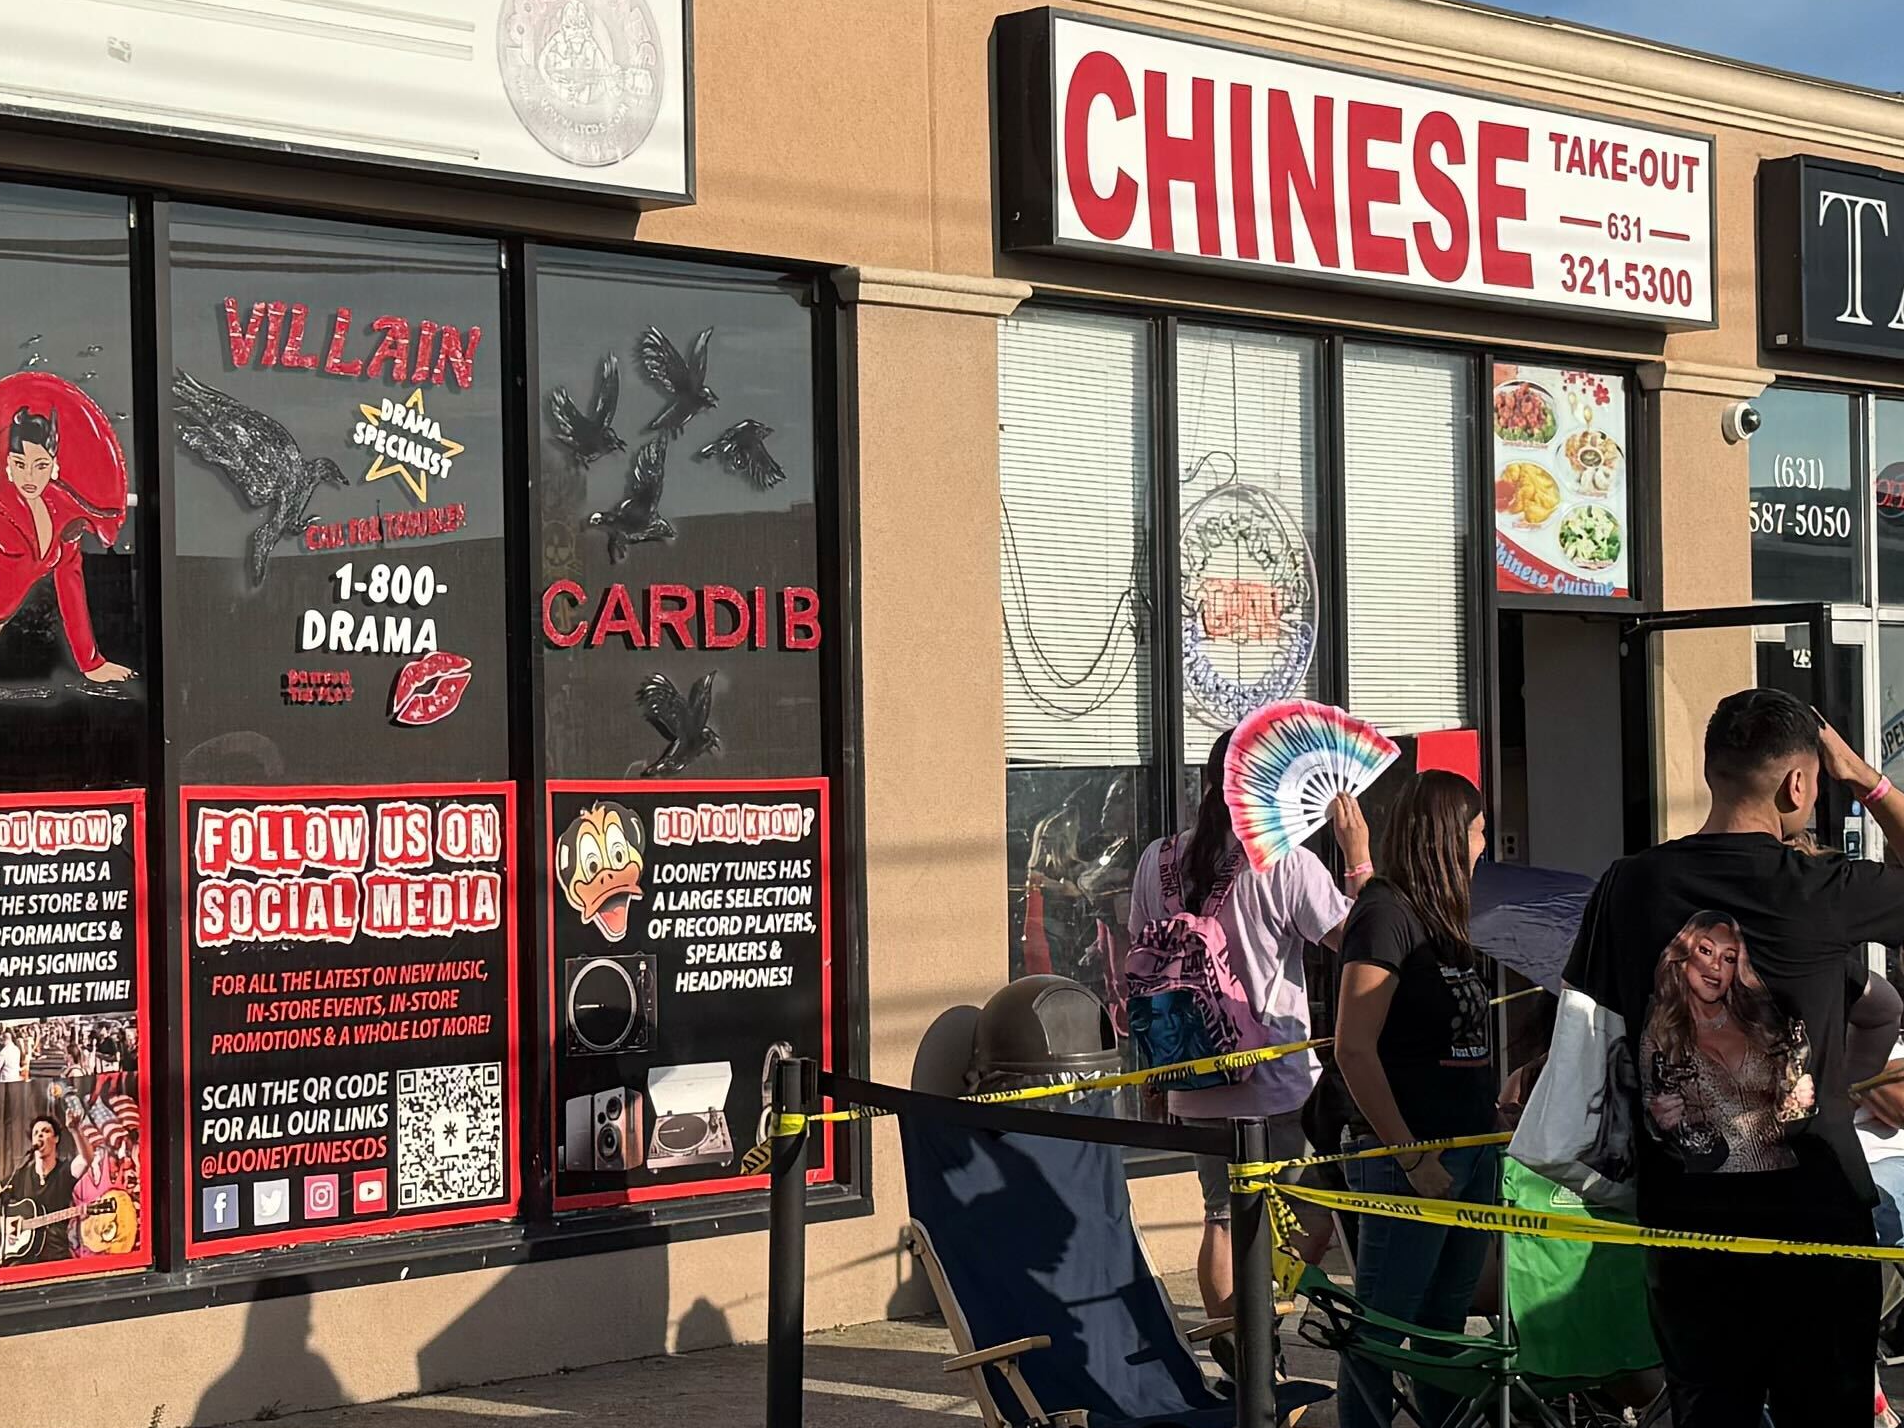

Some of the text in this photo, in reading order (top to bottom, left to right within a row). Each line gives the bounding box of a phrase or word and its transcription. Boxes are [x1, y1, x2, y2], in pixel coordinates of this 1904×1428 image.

[1065, 49, 1534, 290] CHINESE
[1548, 131, 1700, 193] TAKE-OUT
[1607, 212, 1642, 243] 631
[1560, 253, 1693, 308] 321-5300
[222, 295, 483, 390] VILLAIN
[380, 397, 443, 443] DRAMA
[352, 420, 454, 479] SPECIALIST
[1773, 454, 1825, 492] (631)
[1749, 501, 1852, 539] 587-5050
[335, 562, 449, 607] 1-800-
[1496, 540, 1616, 597] hinese Cuisine
[302, 608, 439, 655] DRAMA
[542, 578, 822, 651] CARDI B
[36, 812, 129, 850] KNOW?
[202, 811, 496, 865] FOLLOW US ON
[657, 806, 815, 842] DID YOU KNOW?
[3, 863, 62, 886] TUNES
[61, 861, 97, 883] HAS
[97, 860, 111, 882] A
[652, 859, 812, 885] LOONEY TUNES HAS
[28, 891, 85, 915] STORE
[85, 890, 100, 912] &
[101, 889, 129, 911] WE
[202, 878, 496, 935] SOCIAL MEDIA
[652, 884, 813, 912] A LARGE SELECTION
[108, 919, 124, 942] &
[648, 911, 817, 939] OF RECORD PLAYERS,
[36, 950, 118, 976] SIGNINGS
[686, 939, 783, 966] SPEAKERS &
[13, 985, 45, 1008] ALL
[48, 982, 82, 1005] THE
[84, 979, 131, 1003] TIME!
[211, 959, 489, 996] FOR ALL THE LATEST ON NEW MUSIC,
[675, 967, 794, 993] HEADPHONES!
[246, 989, 460, 1024] IN-STORE EVENTS, IN-STORE
[211, 1014, 492, 1055] PROMOTIONS & A WHOLE LOT MORE!
[201, 1071, 390, 1112] SCAN THE QR CODE
[201, 1103, 390, 1145] FOR ALL OUR LINKS
[200, 1135, 388, 1180] @LOONEYTUNESCDS
